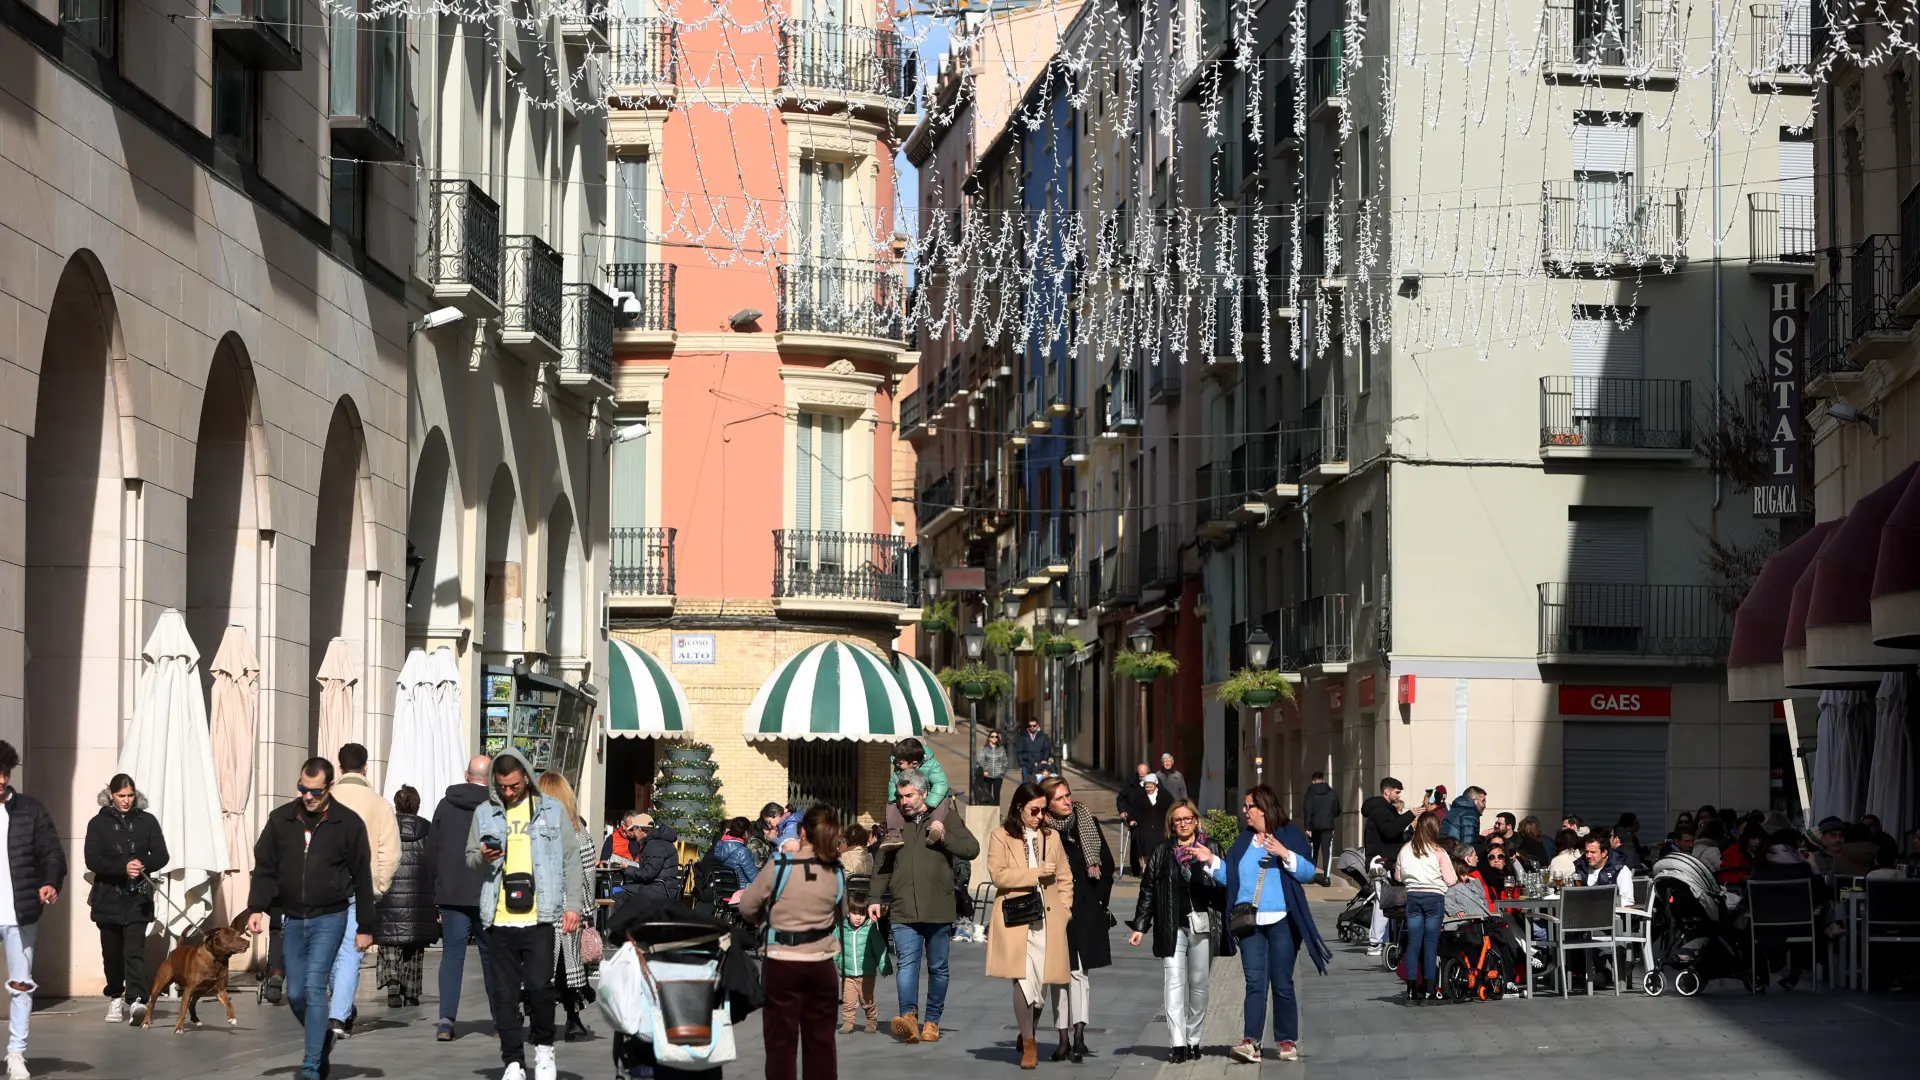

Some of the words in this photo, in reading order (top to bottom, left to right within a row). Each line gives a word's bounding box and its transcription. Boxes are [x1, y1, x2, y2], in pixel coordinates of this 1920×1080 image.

[1771, 282, 1797, 475] HOSTAL
[1753, 484, 1797, 514] RUGACA
[1590, 693, 1641, 711] GAES
